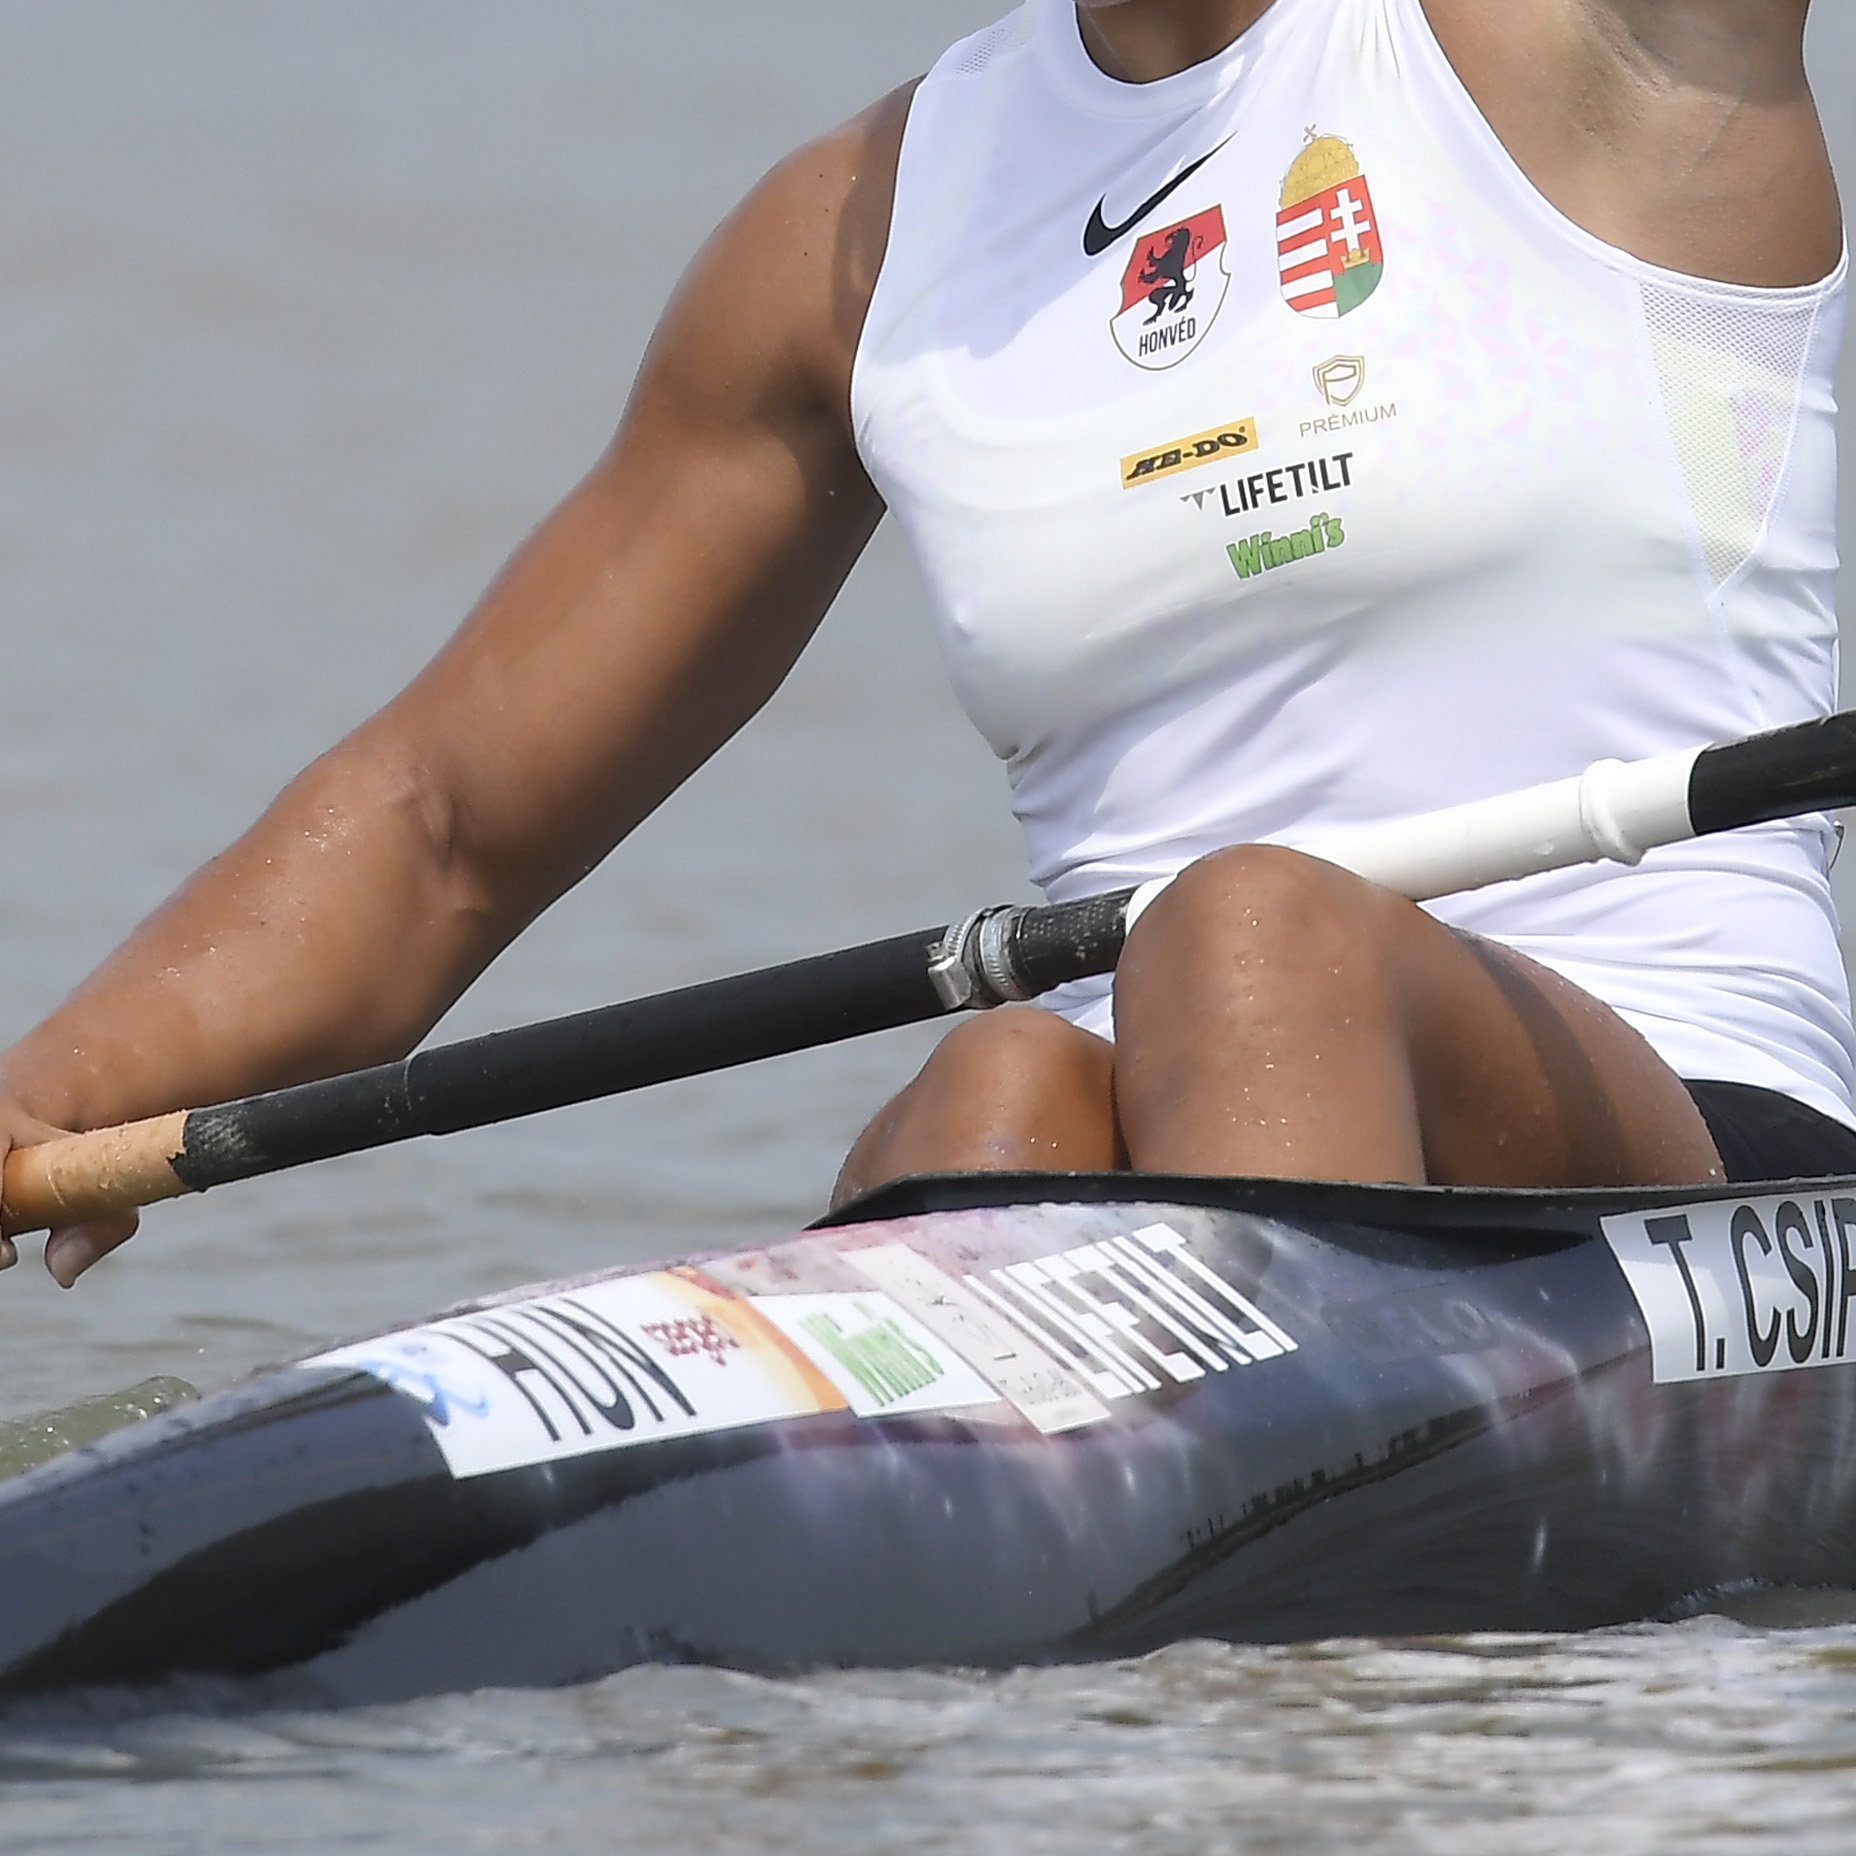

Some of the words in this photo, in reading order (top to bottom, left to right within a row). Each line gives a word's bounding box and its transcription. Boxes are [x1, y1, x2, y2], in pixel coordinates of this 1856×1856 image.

[1138, 316, 1197, 357] HONVÉD
[1299, 403, 1397, 437] PRÉMIUM
[1220, 452, 1353, 518] LIFETILT
[1226, 512, 1346, 580] Winni's
[961, 1221, 1299, 1400] LIFETILT
[1644, 1213, 1726, 1372] T.
[429, 1296, 698, 1443] HUN
